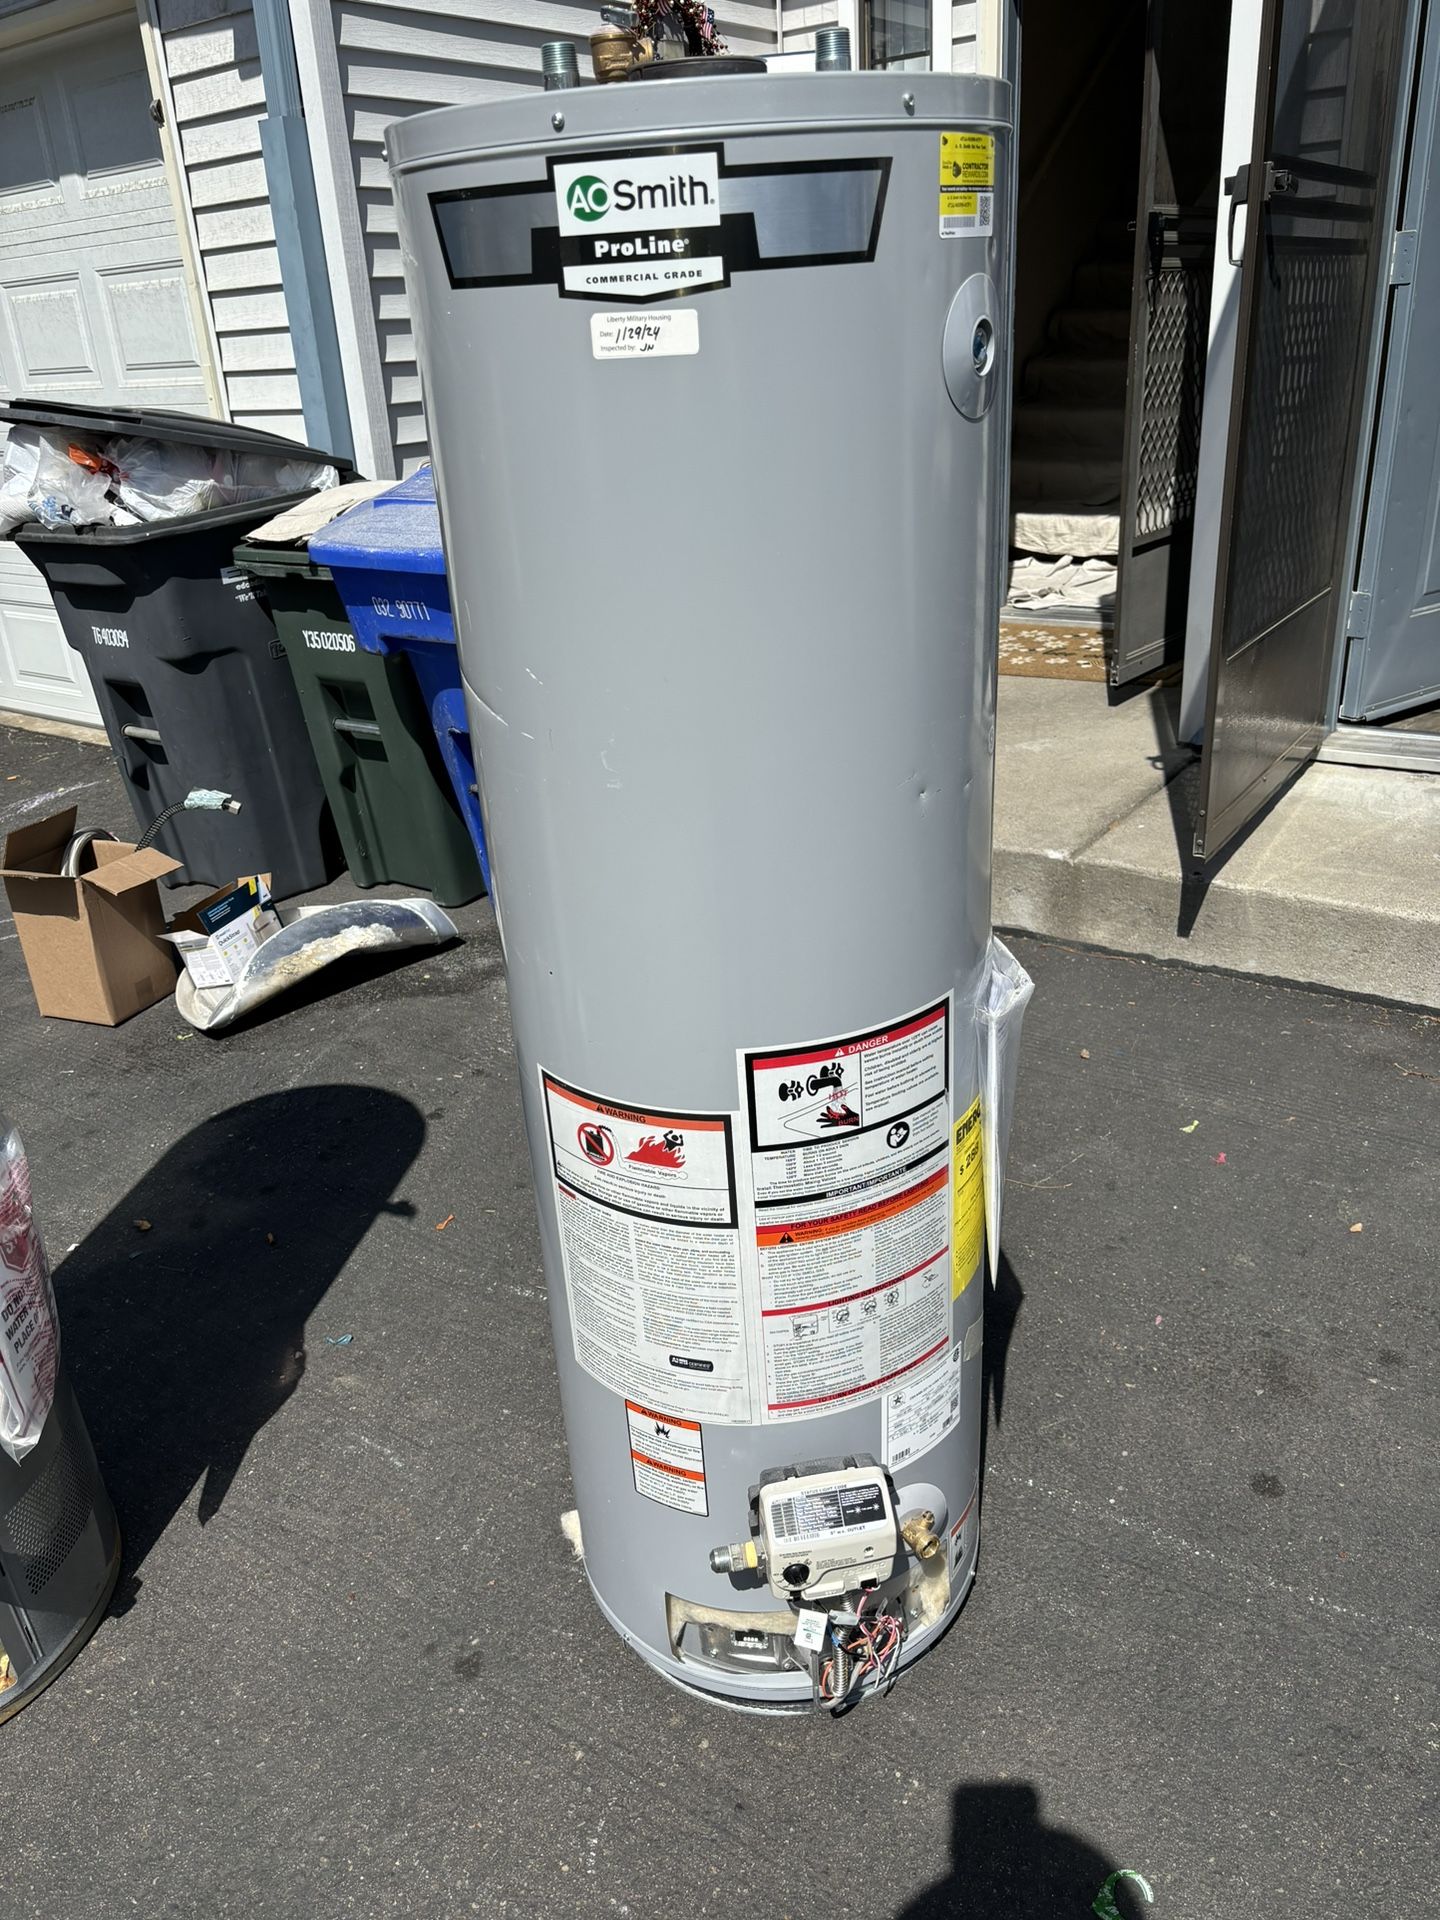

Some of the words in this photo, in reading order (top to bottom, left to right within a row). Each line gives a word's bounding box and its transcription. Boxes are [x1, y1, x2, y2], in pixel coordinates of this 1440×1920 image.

[585, 273, 659, 284] COMMERCIAL
[664, 270, 703, 279] GRADE
[626, 315, 647, 323] Military
[648, 314, 672, 322] Housing
[848, 1035, 889, 1053] DANGER
[604, 1108, 646, 1124] WARNING
[628, 1164, 656, 1175] Flammable
[658, 1170, 677, 1178] Vapors
[773, 1182, 803, 1190] Thermostatic
[808, 1218, 828, 1227] YOUR
[830, 1211, 857, 1222] SAFETY
[858, 1203, 876, 1213] READ
[877, 1192, 903, 1207] BEFORE
[828, 1290, 859, 1307] LIGHTING
[861, 1275, 905, 1297] INSTRUCTIONS
[6, 1306, 29, 1340] WATER
[14, 1320, 35, 1354] PLACE
[829, 1392, 847, 1401] TURN
[646, 1411, 682, 1426] WARNING
[652, 1461, 687, 1477] WARNING
